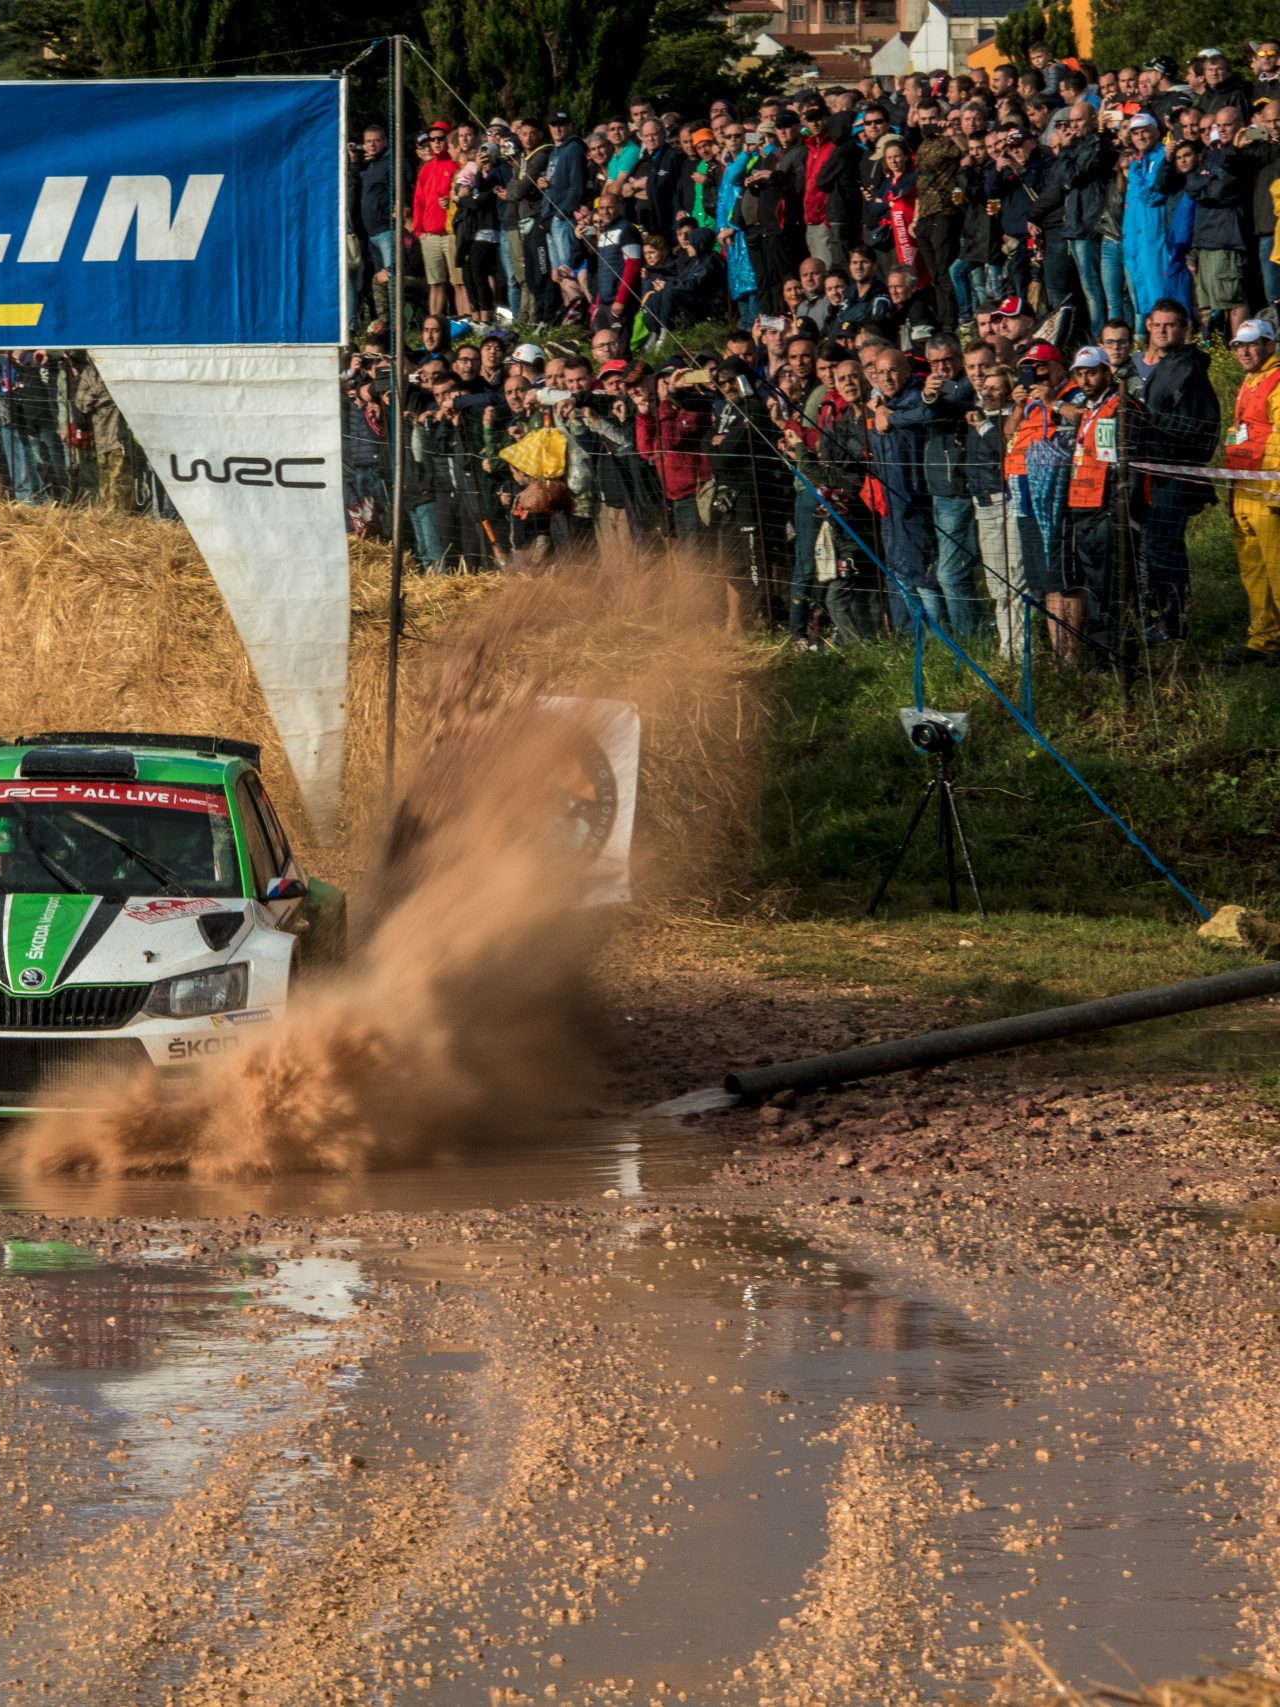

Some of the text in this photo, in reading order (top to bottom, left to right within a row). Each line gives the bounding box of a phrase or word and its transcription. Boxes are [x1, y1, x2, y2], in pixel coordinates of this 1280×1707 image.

[1097, 424, 1113, 446] EXIT
[171, 454, 326, 489] WRC
[83, 788, 120, 799] ALL
[126, 790, 169, 804] LIVE
[25, 924, 51, 960] ŠKODA
